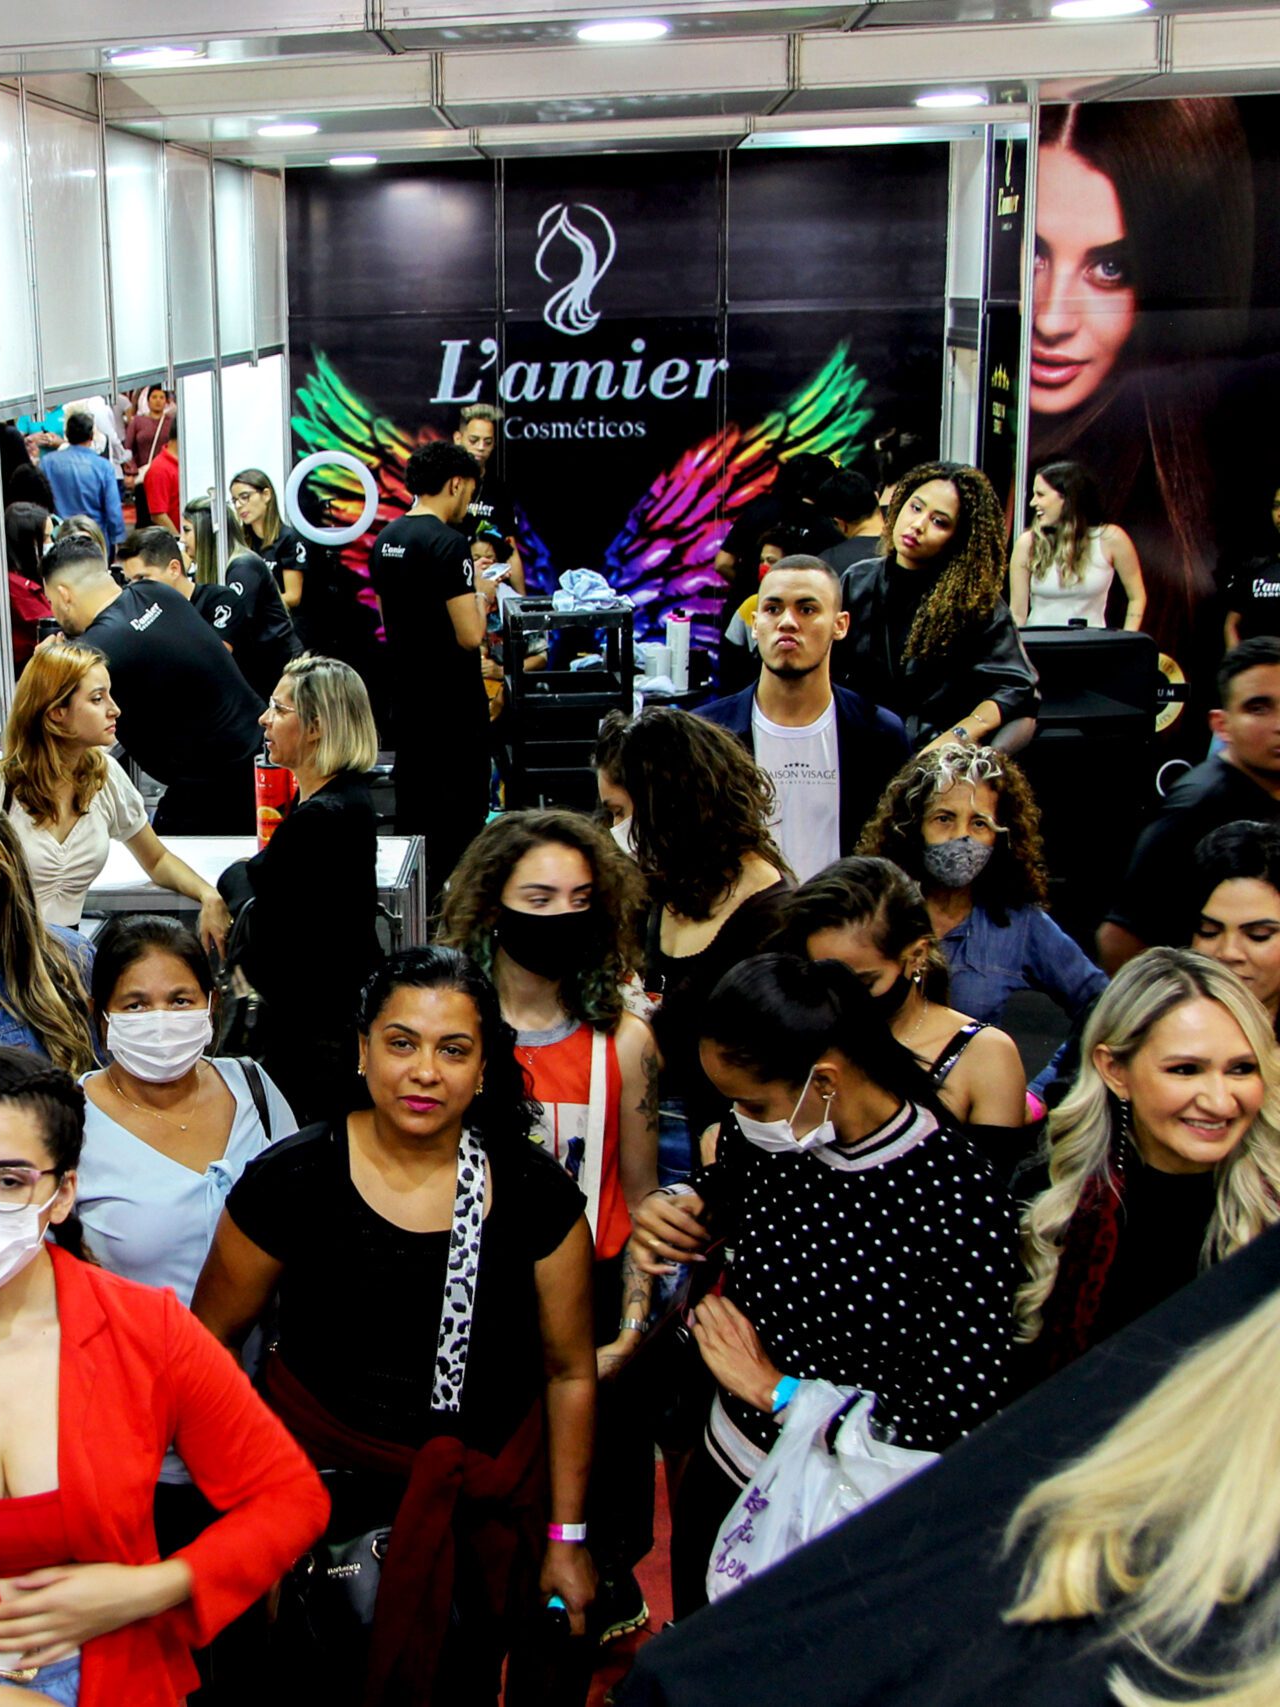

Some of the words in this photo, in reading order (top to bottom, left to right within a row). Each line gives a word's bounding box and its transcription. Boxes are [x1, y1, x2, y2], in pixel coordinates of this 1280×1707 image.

[429, 337, 730, 404] L'amier
[503, 416, 647, 439] Cosméticos
[767, 769, 799, 779] AISON
[801, 769, 837, 780] VISAGÉ
